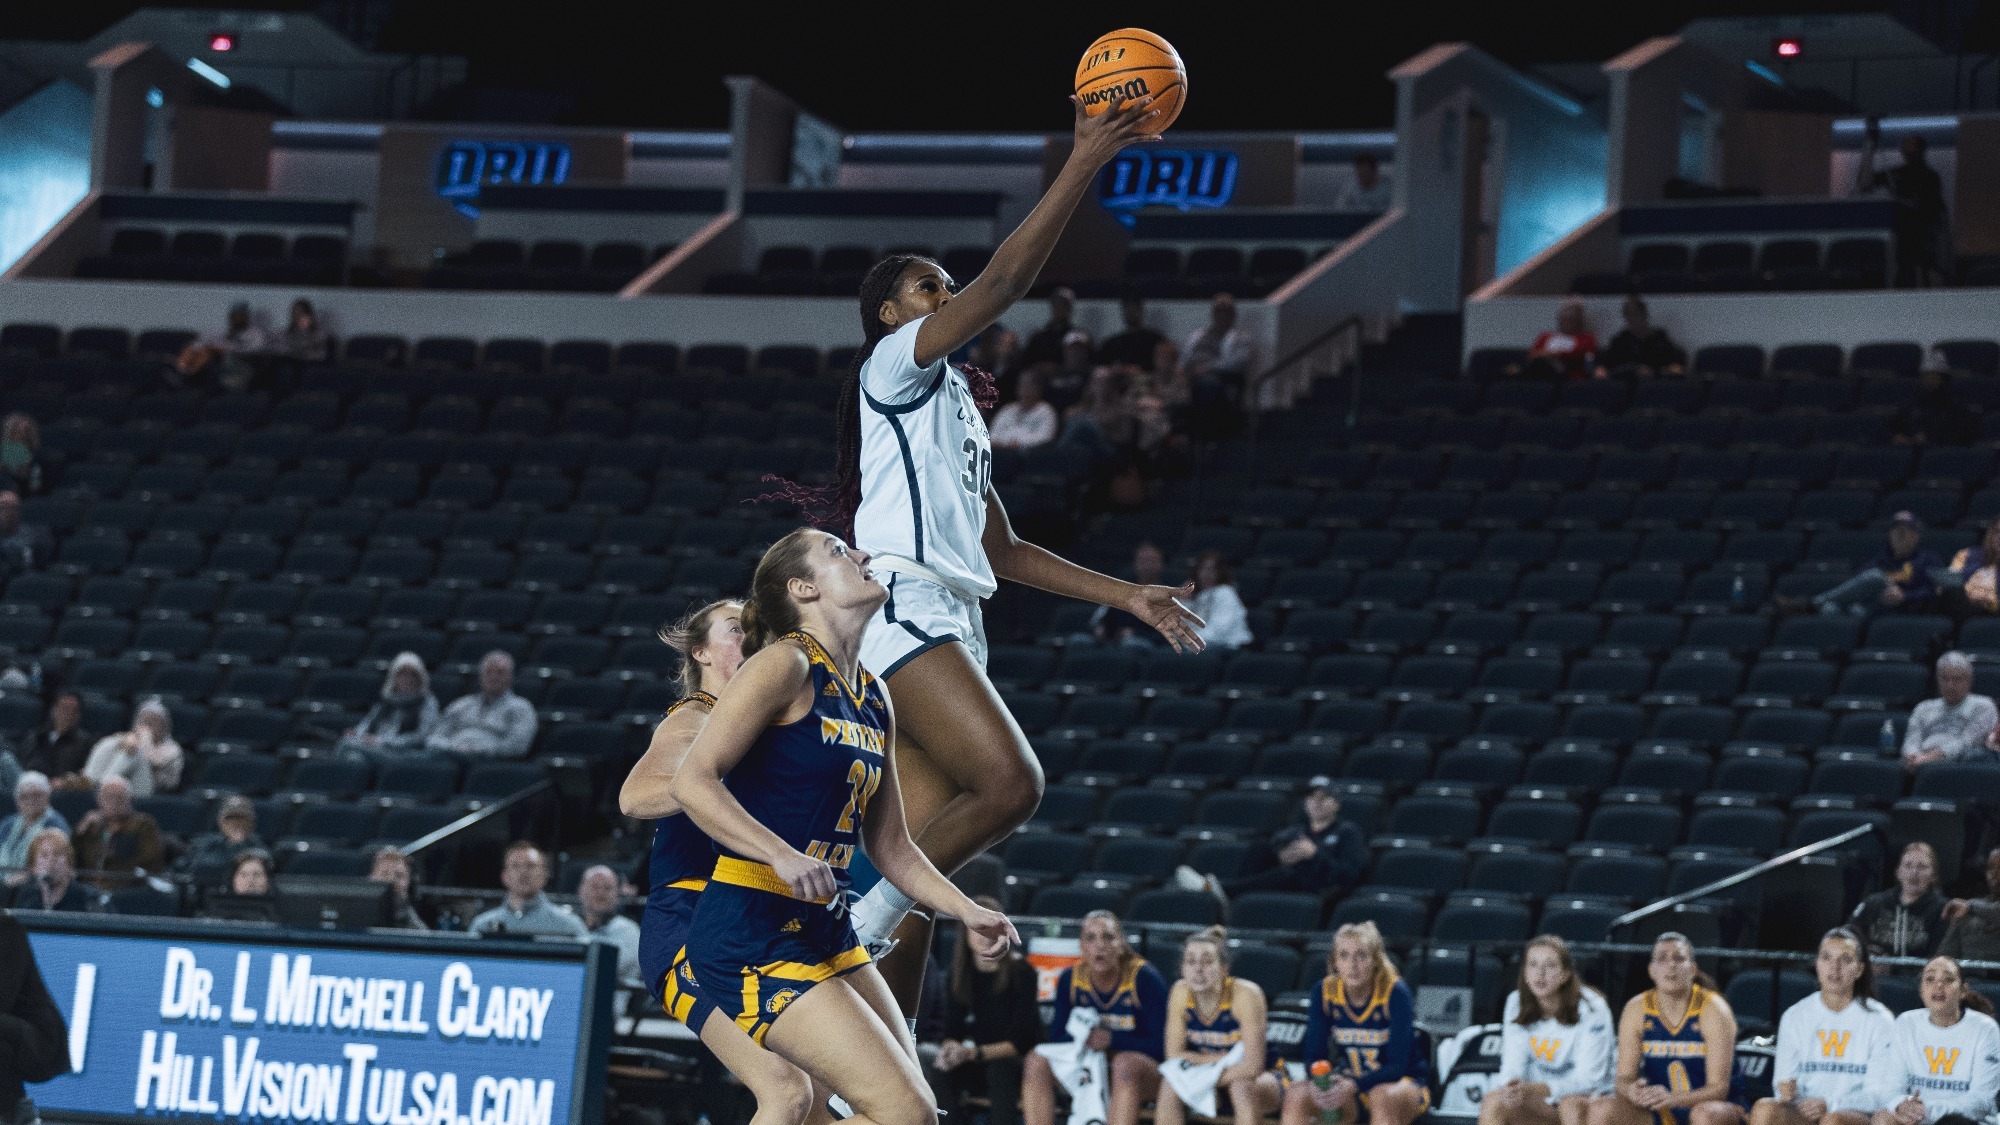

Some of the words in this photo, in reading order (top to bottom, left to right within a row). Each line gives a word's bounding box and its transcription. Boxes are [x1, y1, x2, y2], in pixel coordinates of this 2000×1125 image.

[1081, 77, 1151, 106] Wilson
[1102, 152, 1239, 208] ORU
[960, 436, 991, 502] 30
[231, 951, 258, 1025] L
[1530, 1037, 1561, 1062] W
[1817, 1029, 1851, 1057] W
[1924, 1046, 1961, 1075] W
